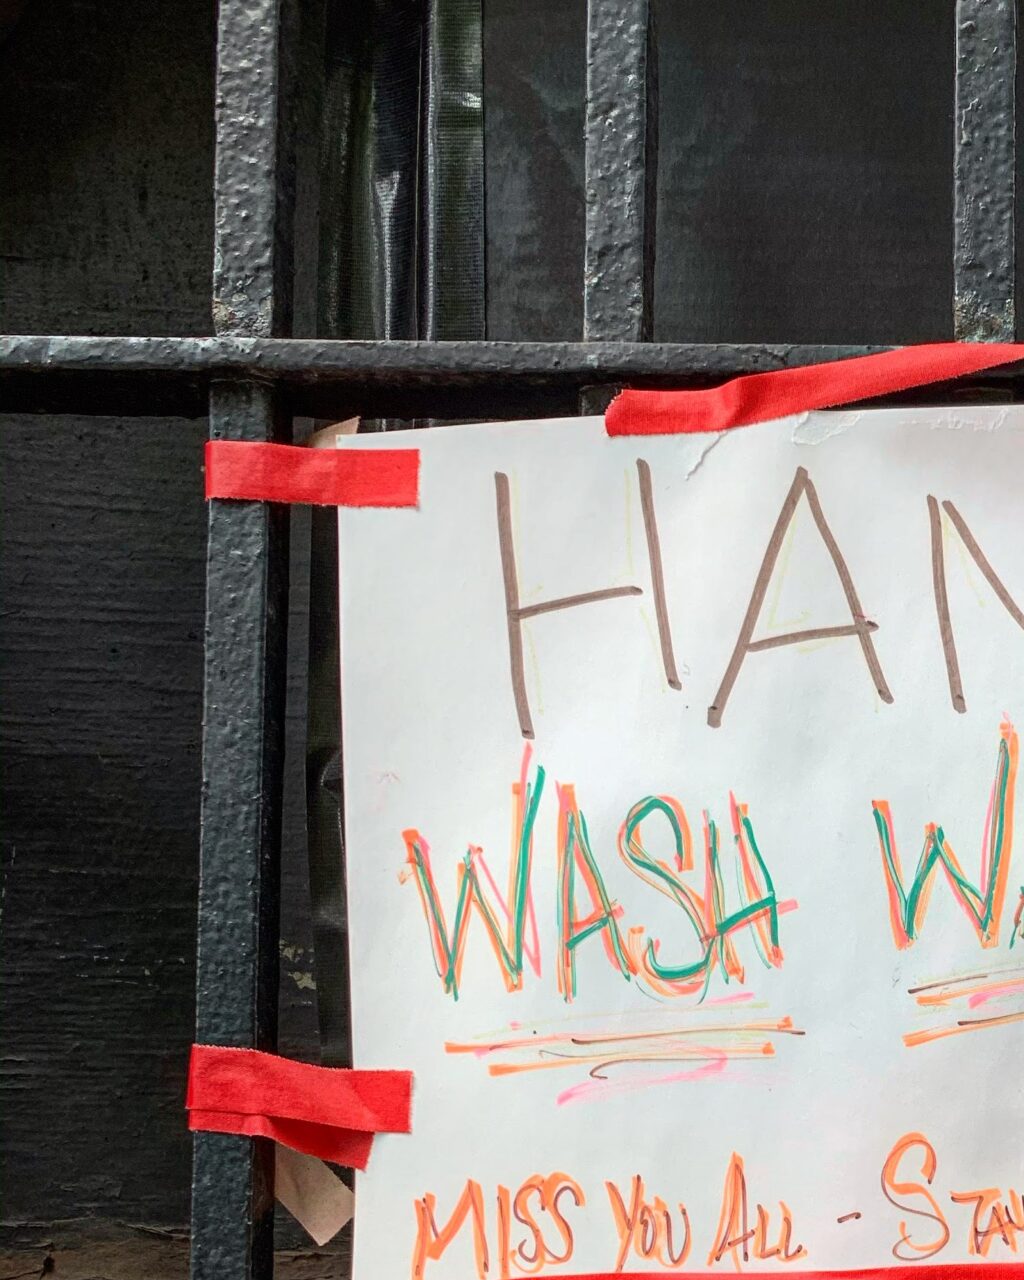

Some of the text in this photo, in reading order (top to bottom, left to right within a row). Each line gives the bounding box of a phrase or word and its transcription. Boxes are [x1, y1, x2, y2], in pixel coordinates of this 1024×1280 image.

[399, 741, 799, 1004] WASH
[604, 1171, 692, 1274] YOU
[707, 1151, 806, 1275] ALL
